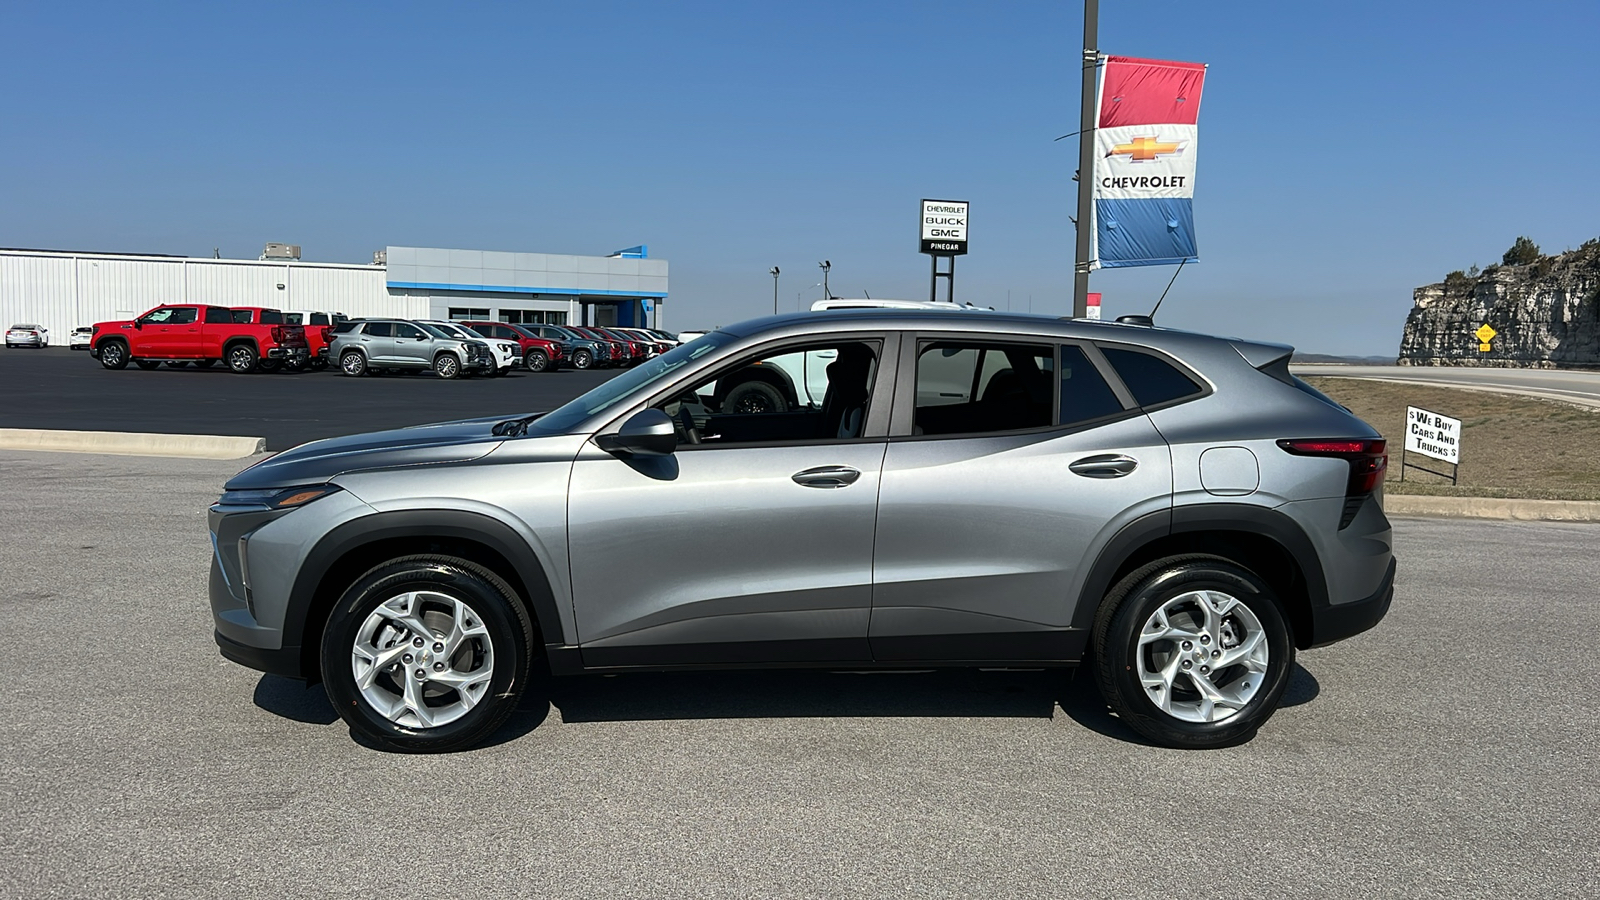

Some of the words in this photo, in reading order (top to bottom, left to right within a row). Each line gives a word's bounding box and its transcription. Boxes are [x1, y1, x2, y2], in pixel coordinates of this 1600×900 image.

[1102, 176, 1186, 188] CHEVROLET
[926, 205, 965, 213] CHEVROLET
[926, 217, 964, 225] BUICK
[931, 229, 960, 237] GMC
[930, 242, 959, 250] PINEGAR
